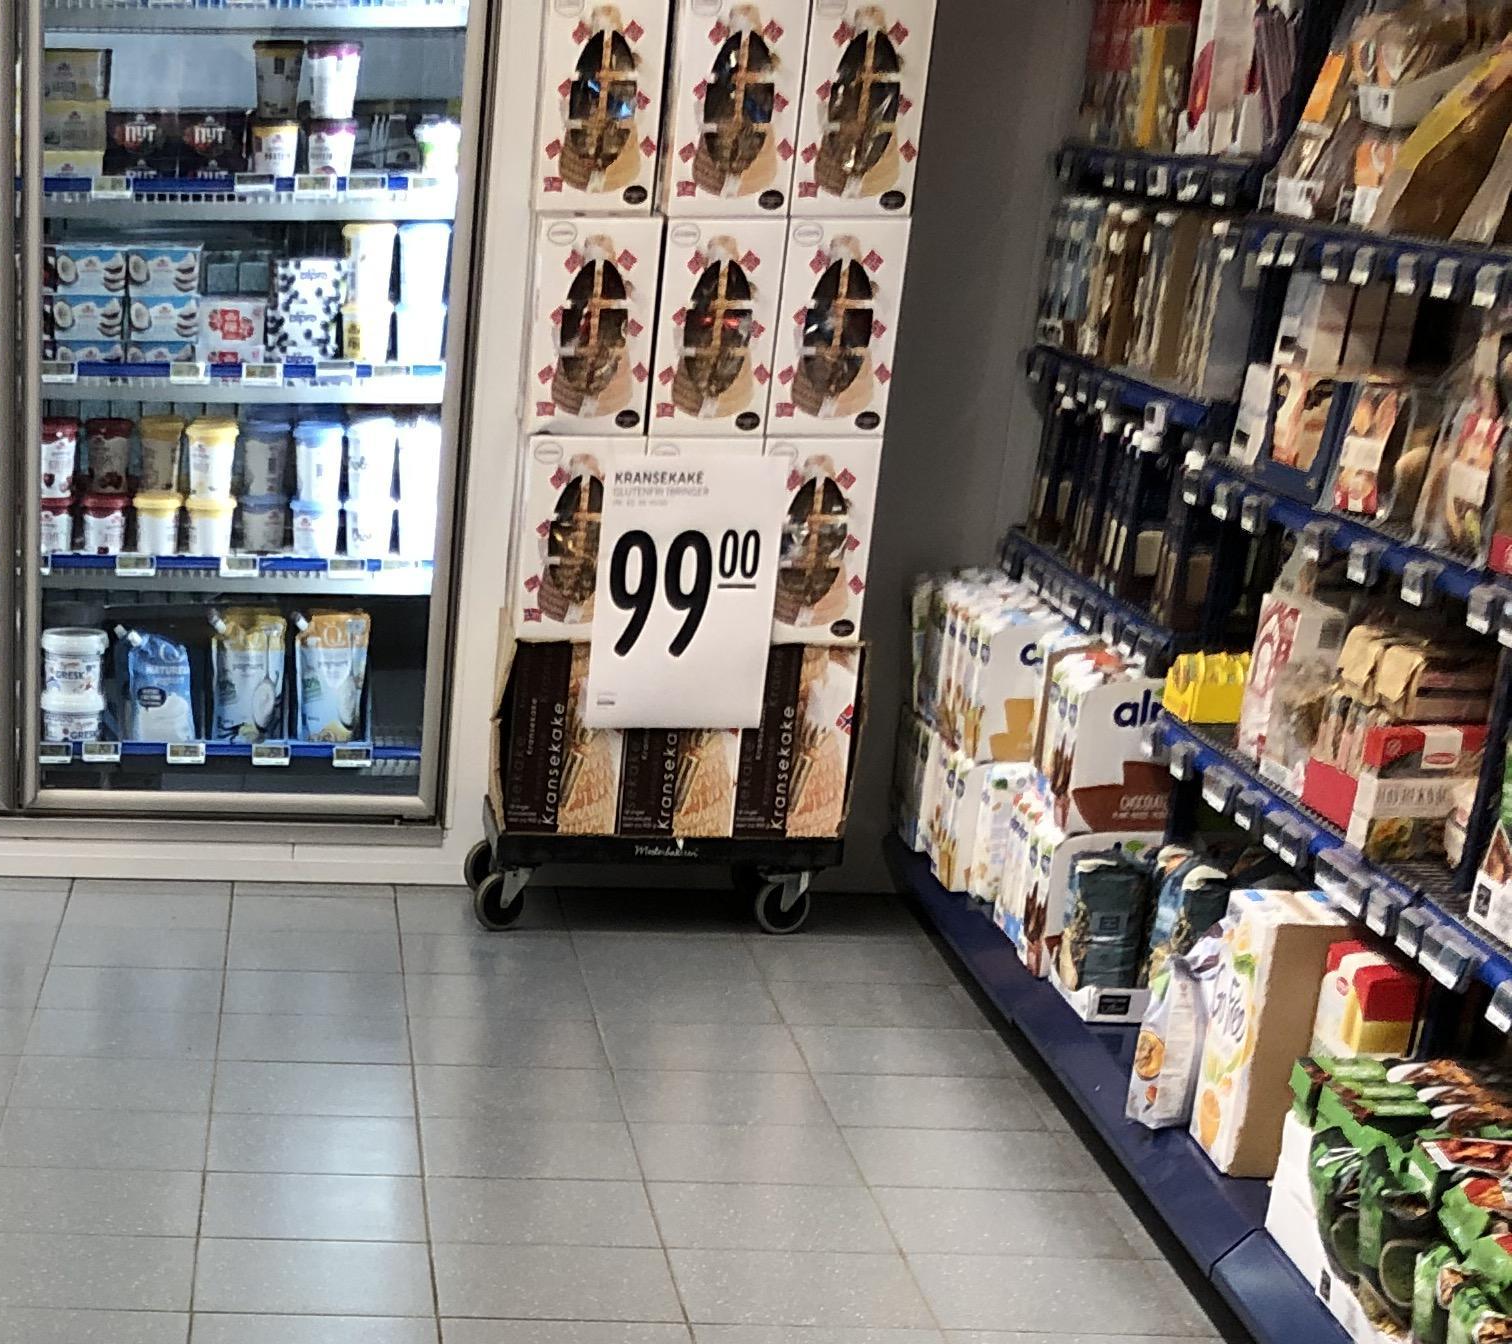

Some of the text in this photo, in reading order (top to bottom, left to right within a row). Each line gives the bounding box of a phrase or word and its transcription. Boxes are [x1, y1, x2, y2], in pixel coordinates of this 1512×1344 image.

[614, 471, 704, 485] KRANSEKAKE
[609, 529, 761, 657] 99 00
[542, 702, 565, 826] Kransekake
[657, 733, 678, 830] Kranseka
[771, 706, 795, 830] Kransekake
